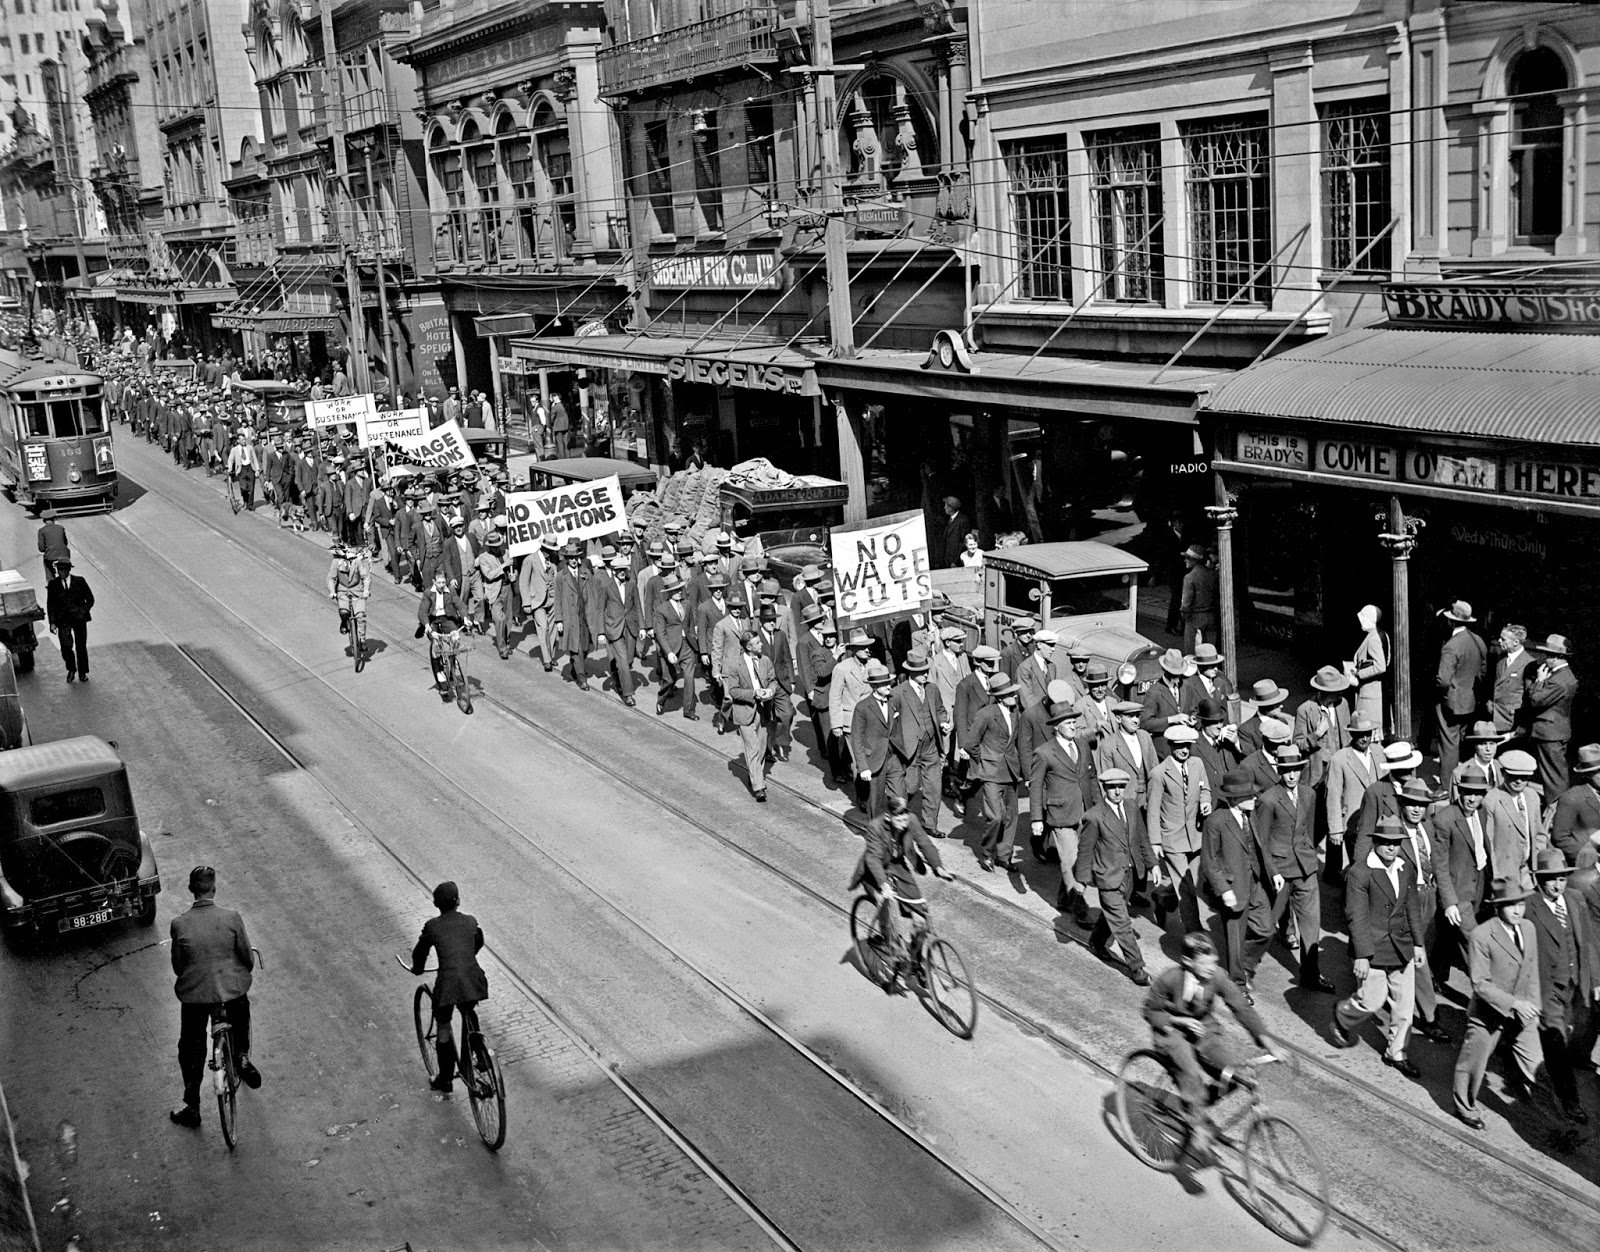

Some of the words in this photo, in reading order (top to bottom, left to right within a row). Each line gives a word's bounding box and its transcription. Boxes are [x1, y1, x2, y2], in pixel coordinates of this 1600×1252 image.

[878, 210, 898, 221] LITTLE
[652, 256, 702, 285] SIBERIAN
[703, 256, 729, 285] FUR
[1385, 285, 1541, 322] BRADY'S
[277, 319, 336, 330] WARDELLS
[668, 357, 786, 391] SIEGEL'S
[326, 400, 352, 409] WORK
[380, 411, 404, 420] WORK
[1244, 445, 1304, 464] BRADY'S
[1250, 434, 1279, 447] THIS
[1286, 437, 1298, 448] IS
[1171, 462, 1207, 474] RADIO
[1323, 442, 1390, 475] COME
[506, 503, 530, 524] NO
[536, 487, 610, 516] WAGE
[754, 489, 797, 503] ADAMS
[508, 504, 616, 545] REDUCTIONS
[857, 533, 901, 562] NO
[1517, 534, 1546, 560] Only
[833, 547, 929, 593] WAGE
[841, 574, 930, 612] CUTS
